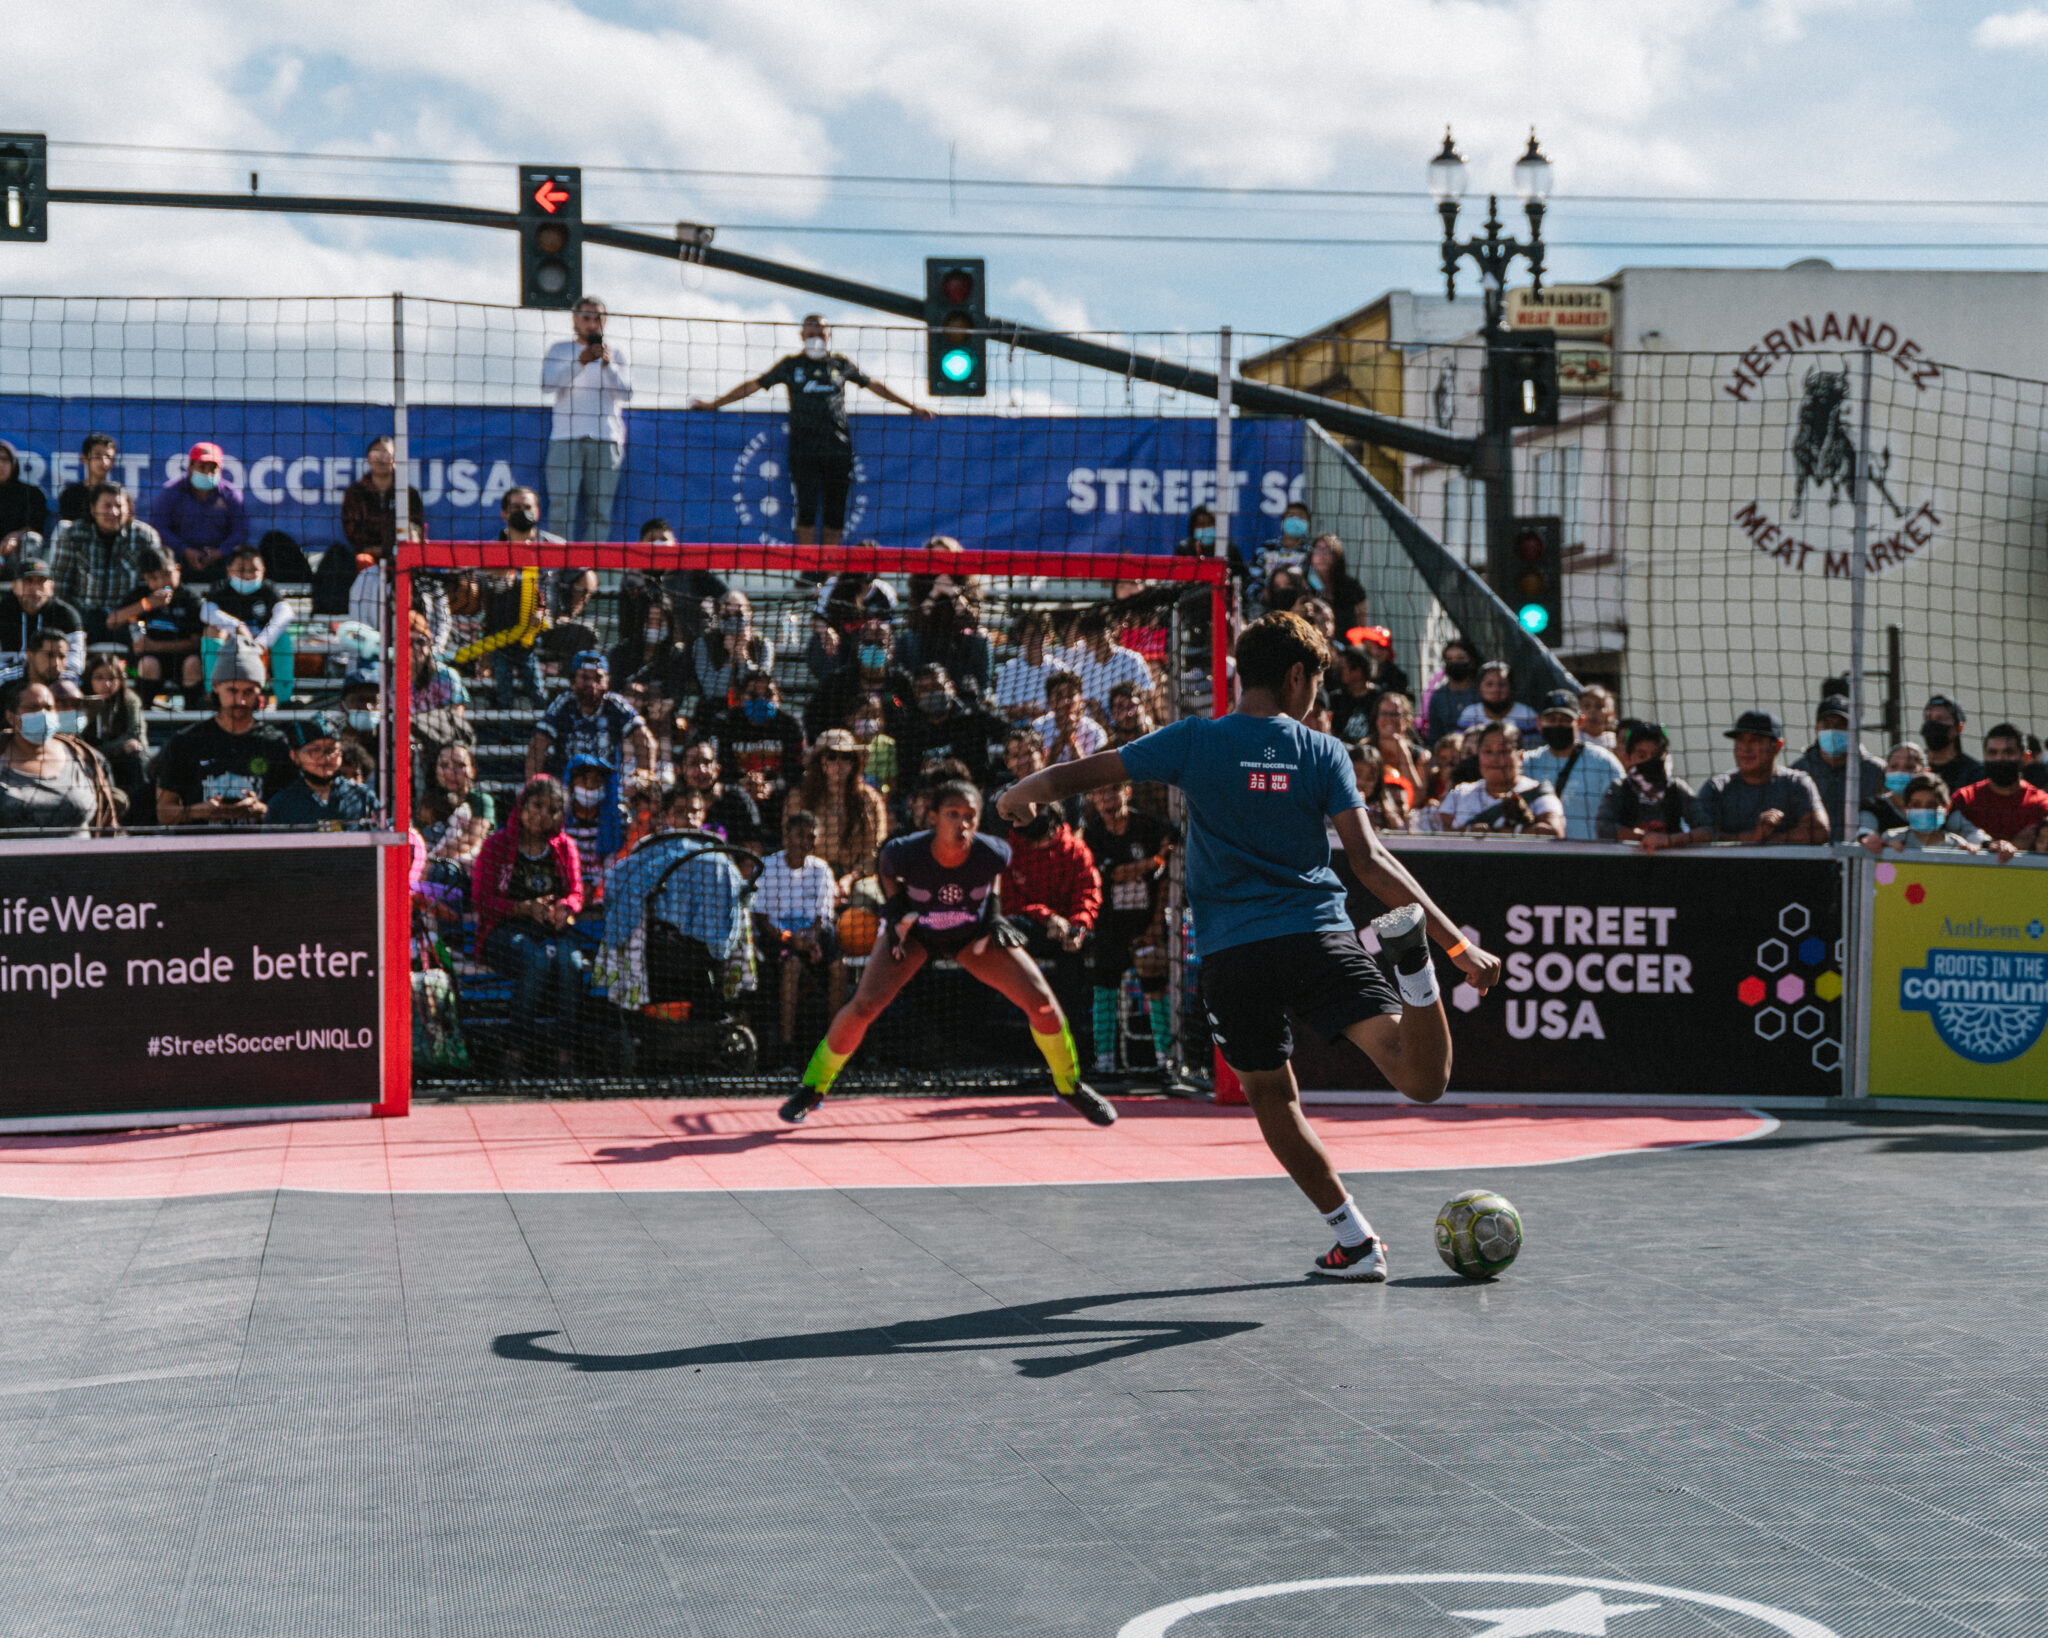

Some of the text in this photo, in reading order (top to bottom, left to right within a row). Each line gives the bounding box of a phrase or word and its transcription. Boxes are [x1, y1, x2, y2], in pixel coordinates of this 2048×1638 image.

[1517, 311, 1607, 326] MEAT MARKET
[1724, 311, 1941, 402] HERNANDEZ
[1066, 467, 1249, 515] STREET
[1734, 501, 1815, 571] MEAT
[0, 895, 164, 934] ifeWear.
[1505, 904, 1677, 946] STREET
[1939, 916, 2020, 939] Anthem
[0, 943, 375, 999] imple made better.
[1505, 952, 1694, 994] SOCCER
[1934, 954, 2045, 981] ROOTS IN THE
[1904, 977, 2048, 1003] communi
[1505, 999, 1606, 1040] USA
[147, 1028, 374, 1057] #StreetSoccerUNIQLO
